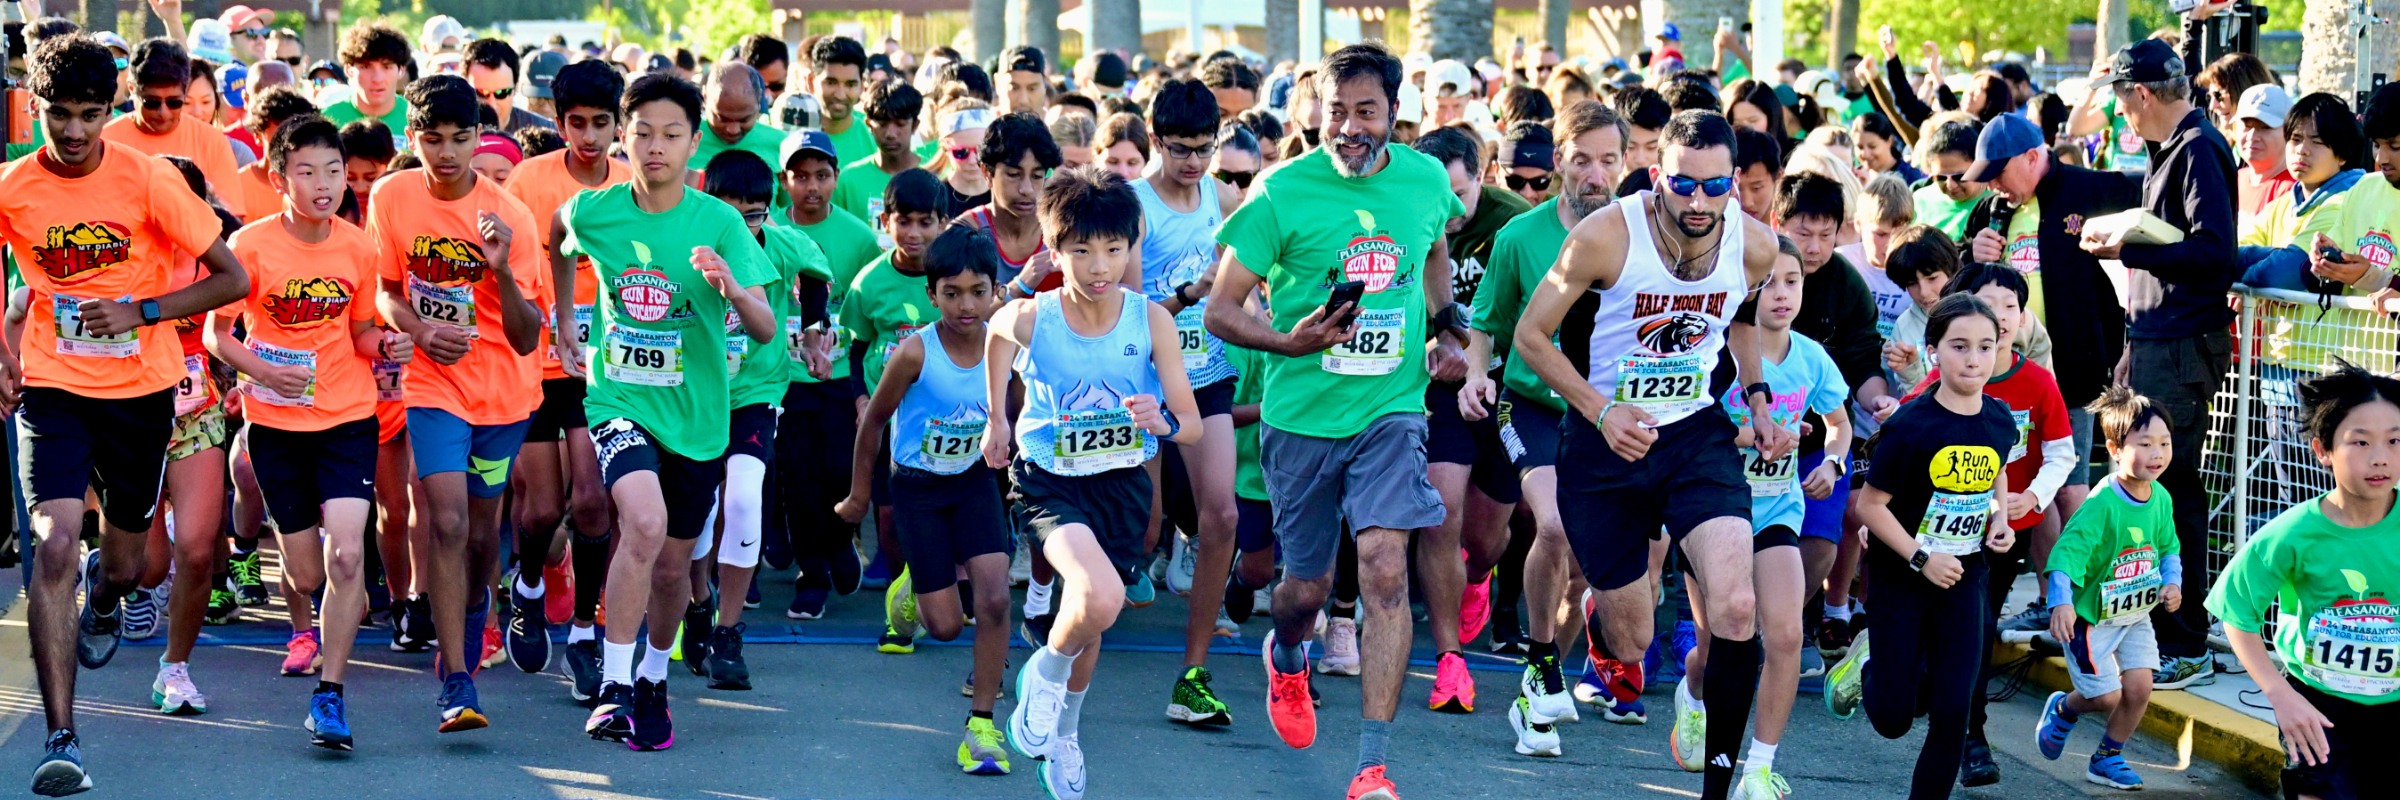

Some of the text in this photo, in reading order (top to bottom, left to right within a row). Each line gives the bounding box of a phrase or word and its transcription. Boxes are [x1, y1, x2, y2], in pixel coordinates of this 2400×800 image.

[95, 239, 129, 250] DIABLO
[1339, 241, 1405, 260] PLEASANTON
[45, 244, 129, 279] HEAT
[1346, 253, 1396, 272] RUN FOR
[614, 275, 678, 292] PLEASANTON
[622, 286, 670, 304] RUN FOR
[420, 296, 459, 322] 622
[624, 302, 669, 321] EDUCATION
[1632, 291, 1728, 320] HALF MOON BAY
[627, 331, 677, 341] PLEASANTON
[638, 338, 677, 346] EDUCATION
[266, 347, 311, 360] PLEASANTO
[619, 344, 665, 369] 769
[1623, 358, 1700, 368] 2024 PLEASANTON
[1660, 365, 1700, 374] EDUCATION
[1628, 375, 1693, 398] 1232
[1065, 426, 1132, 453] 1233
[1962, 451, 1989, 467] Run
[1964, 466, 1994, 485] Club
[1934, 513, 1984, 536] 1496
[2115, 561, 2137, 578] RUN
[2110, 587, 2157, 615] 1416
[2324, 605, 2399, 616] PLEASANTON
[2314, 626, 2400, 643] RUN FOR EDUCATION
[2342, 624, 2400, 635] PLEASANTON
[2319, 640, 2394, 674] 1415
